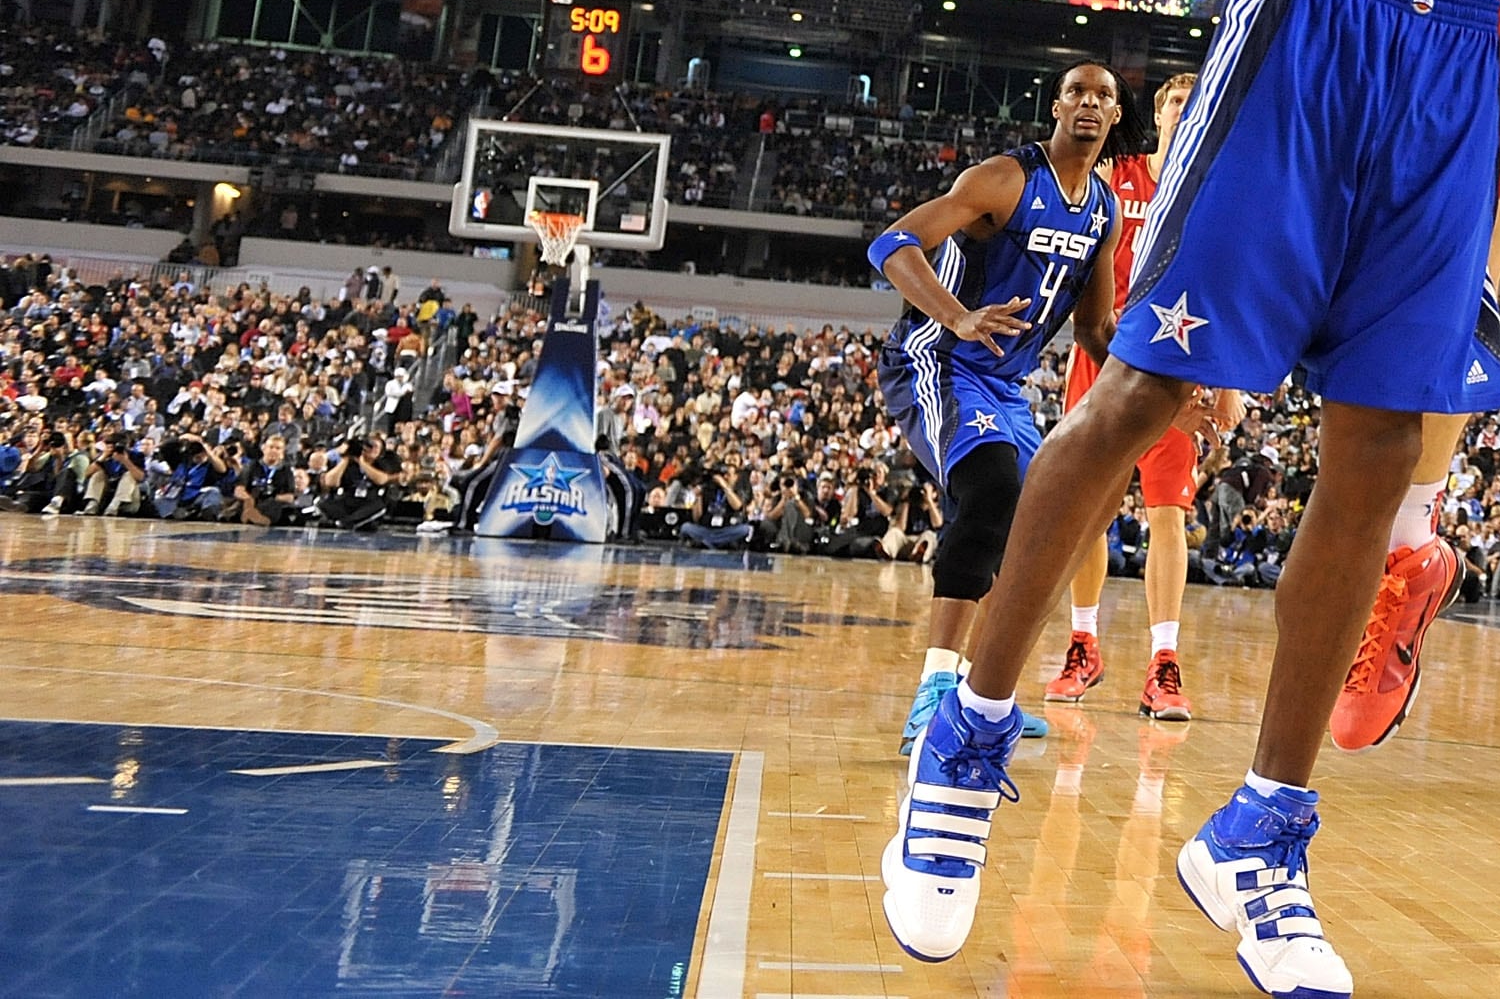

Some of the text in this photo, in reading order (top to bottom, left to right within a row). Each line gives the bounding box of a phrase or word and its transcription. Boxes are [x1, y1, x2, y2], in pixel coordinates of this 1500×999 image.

[570, 7, 619, 33] 5:09
[581, 34, 610, 74] 6
[1027, 227, 1098, 260] EAST
[1037, 261, 1068, 325] 4
